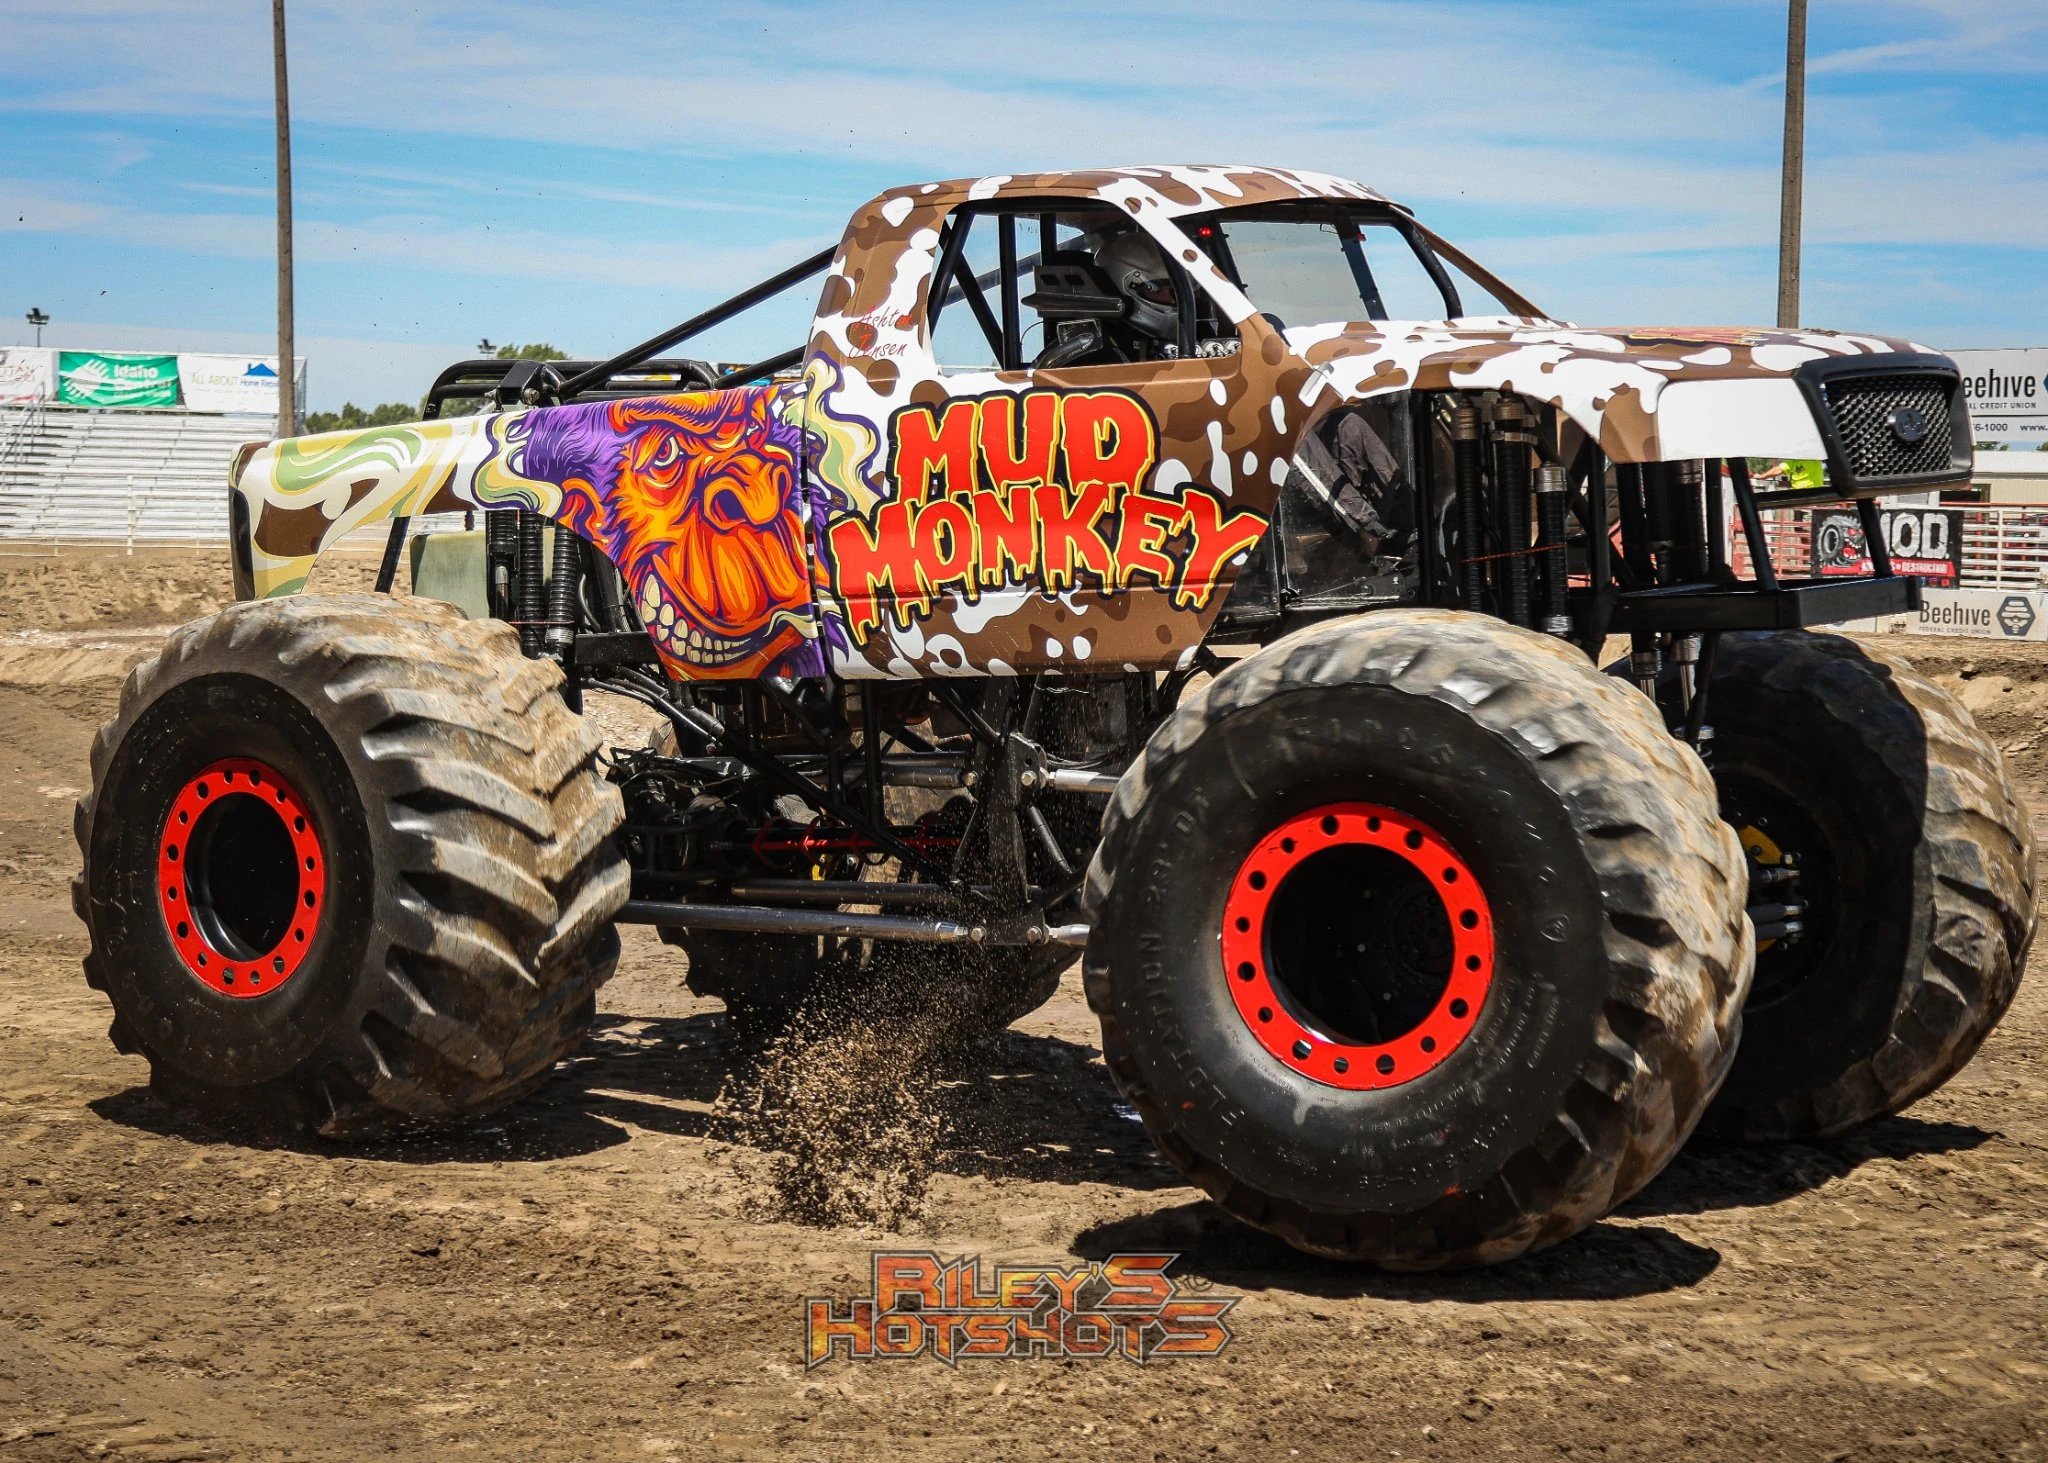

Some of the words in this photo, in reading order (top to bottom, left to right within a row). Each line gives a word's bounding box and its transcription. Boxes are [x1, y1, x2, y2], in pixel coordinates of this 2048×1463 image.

[113, 364, 159, 379] Idaho
[1961, 369, 2036, 398] eehive
[1973, 423, 2008, 431] 6-1000
[890, 388, 1159, 509] MUD
[828, 484, 1270, 646] MONKEY
[1919, 600, 1991, 626] Beehive
